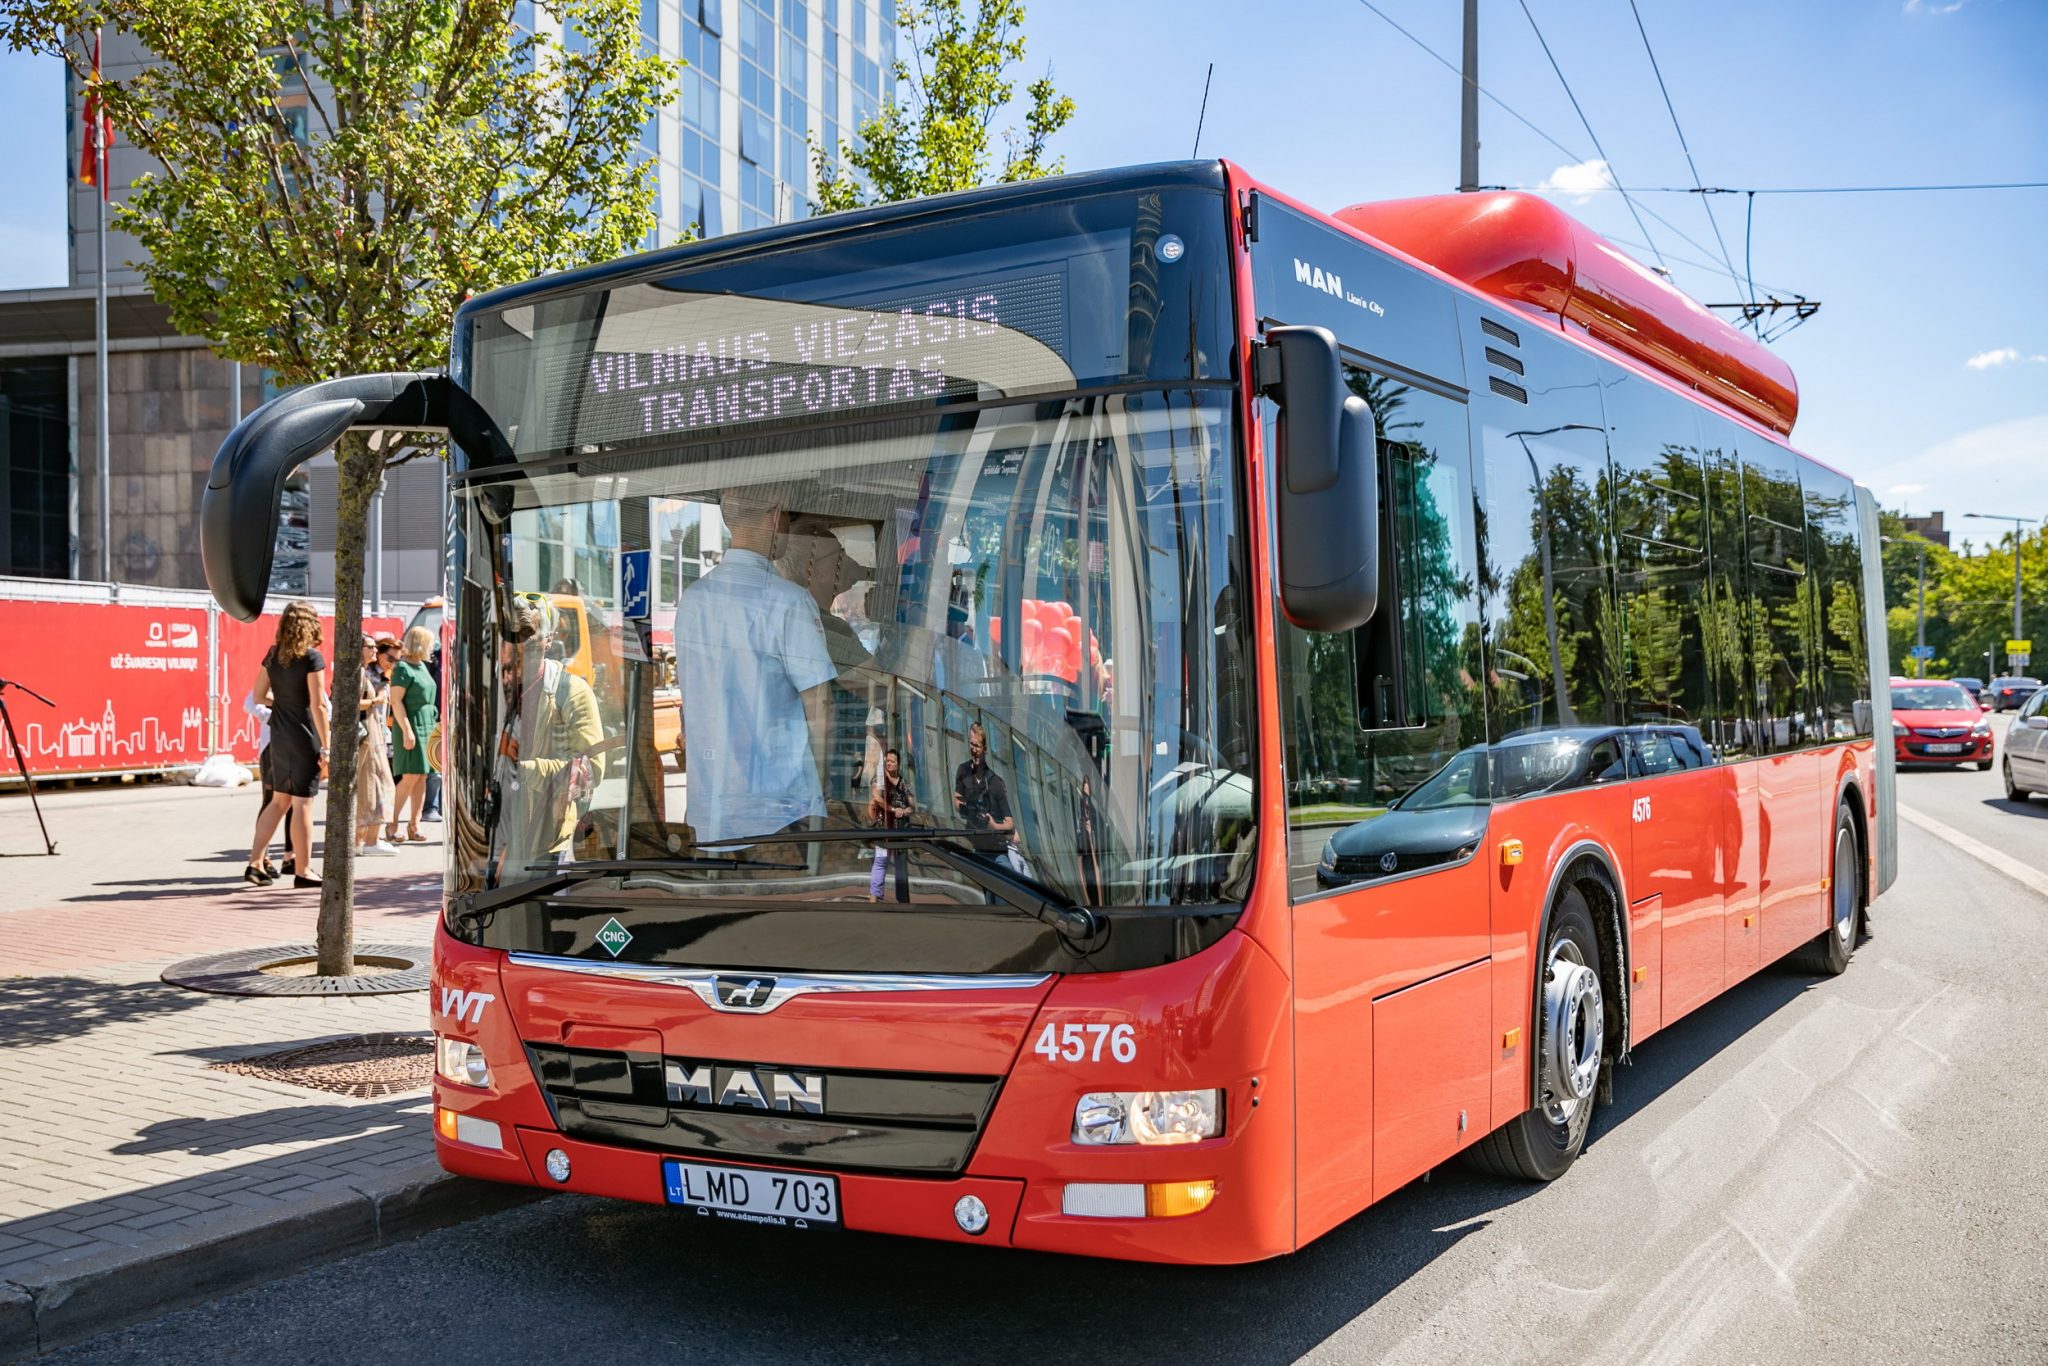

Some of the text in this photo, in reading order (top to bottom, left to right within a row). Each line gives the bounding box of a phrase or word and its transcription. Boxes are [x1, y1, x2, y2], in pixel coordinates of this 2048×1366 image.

[1294, 257, 1385, 318] MAN Lion's City
[592, 294, 998, 393] VILNIAUS VIEŠASIS
[639, 354, 946, 432] TRANSPORTAS
[1632, 796, 1652, 823] 4576
[603, 931, 626, 943] CNG
[442, 987, 495, 1024] VVT
[1034, 1023, 1137, 1063] 4576
[665, 1065, 824, 1114] MAN
[669, 1168, 831, 1216] LT LMD 703
[716, 1210, 787, 1225] www.adampolis.lt
